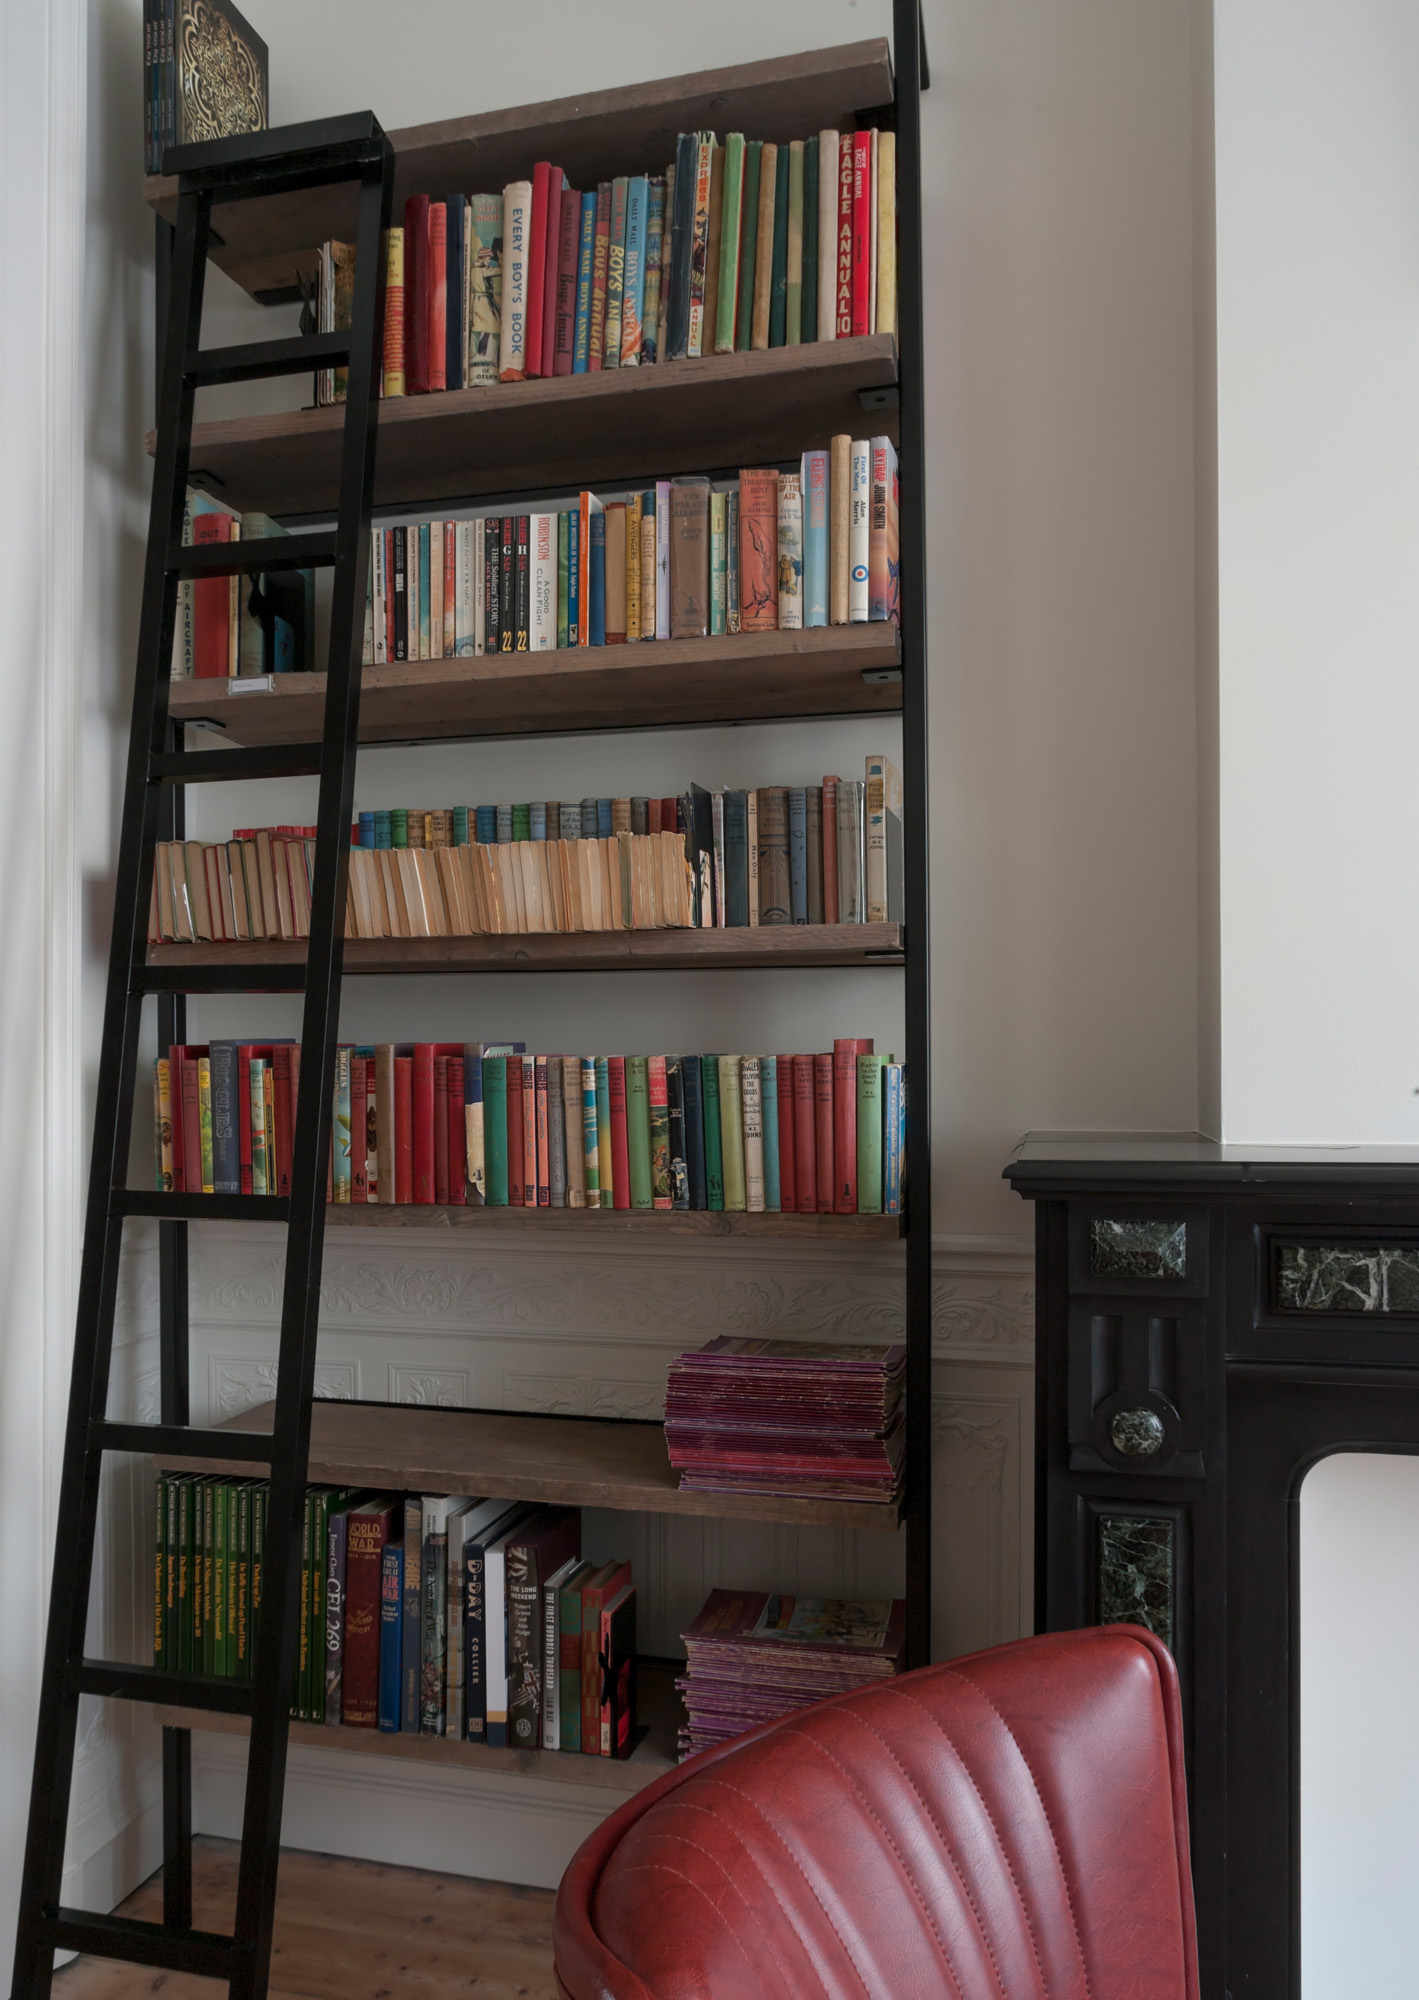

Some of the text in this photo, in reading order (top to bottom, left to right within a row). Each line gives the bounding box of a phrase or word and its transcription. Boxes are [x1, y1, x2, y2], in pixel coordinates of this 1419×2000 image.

[701, 131, 711, 144] TV
[855, 149, 863, 168] EAGLE
[699, 146, 709, 202] EXPRESS
[564, 203, 573, 234] DAILY
[614, 216, 623, 240] MAIL
[837, 138, 853, 333] EAGLE ANNUAL 10
[562, 238, 571, 262] MAIL
[608, 244, 624, 291] BOYS
[625, 251, 638, 287] BOYS
[512, 208, 522, 354] EVERY BOY'S BOOK
[576, 210, 593, 361] DAILY MAIL BOYS ANNUAL
[557, 306, 572, 354] Annual
[589, 288, 606, 357] Annual
[606, 299, 620, 356] ANNUAL
[621, 290, 636, 345] ANNUAL
[860, 475, 867, 484] Of
[873, 448, 886, 529] SKYTRAP JOHN SMITH
[783, 493, 797, 501] AIR
[811, 458, 825, 528] FLYING STORIES
[200, 529, 219, 538] OUT
[538, 517, 550, 560] ROBINSON
[630, 521, 638, 561] AVENGERS
[491, 547, 499, 565] THE
[502, 545, 512, 555] G
[518, 545, 527, 555] H
[184, 583, 190, 598] OF
[491, 598, 499, 626] STORY
[502, 631, 512, 651] 22
[517, 631, 527, 651] 22
[340, 1051, 348, 1087] BIGGLES
[523, 1063, 533, 1090] BIGGLES
[536, 1064, 547, 1090] BIGGLES
[214, 1052, 232, 1138] BIGGLES
[525, 1184, 534, 1201] Dean
[539, 1185, 548, 1203] Dean
[349, 1538, 374, 1549] WAR
[425, 1560, 435, 1575] The
[326, 1534, 341, 1651] Ernest Claes CEL 269
[382, 1576, 399, 1587] AIR
[382, 1588, 399, 1599] WAR
[426, 1576, 435, 1607] Nature
[515, 1602, 531, 1610] Robert
[427, 1620, 436, 1642] War
[467, 1559, 482, 1685] D-DAY COLLIER
[515, 1629, 531, 1637] Hodge
[546, 1592, 555, 1689] THE FIRST HUNDRED THOUSAND
[546, 1709, 554, 1723] HAY
